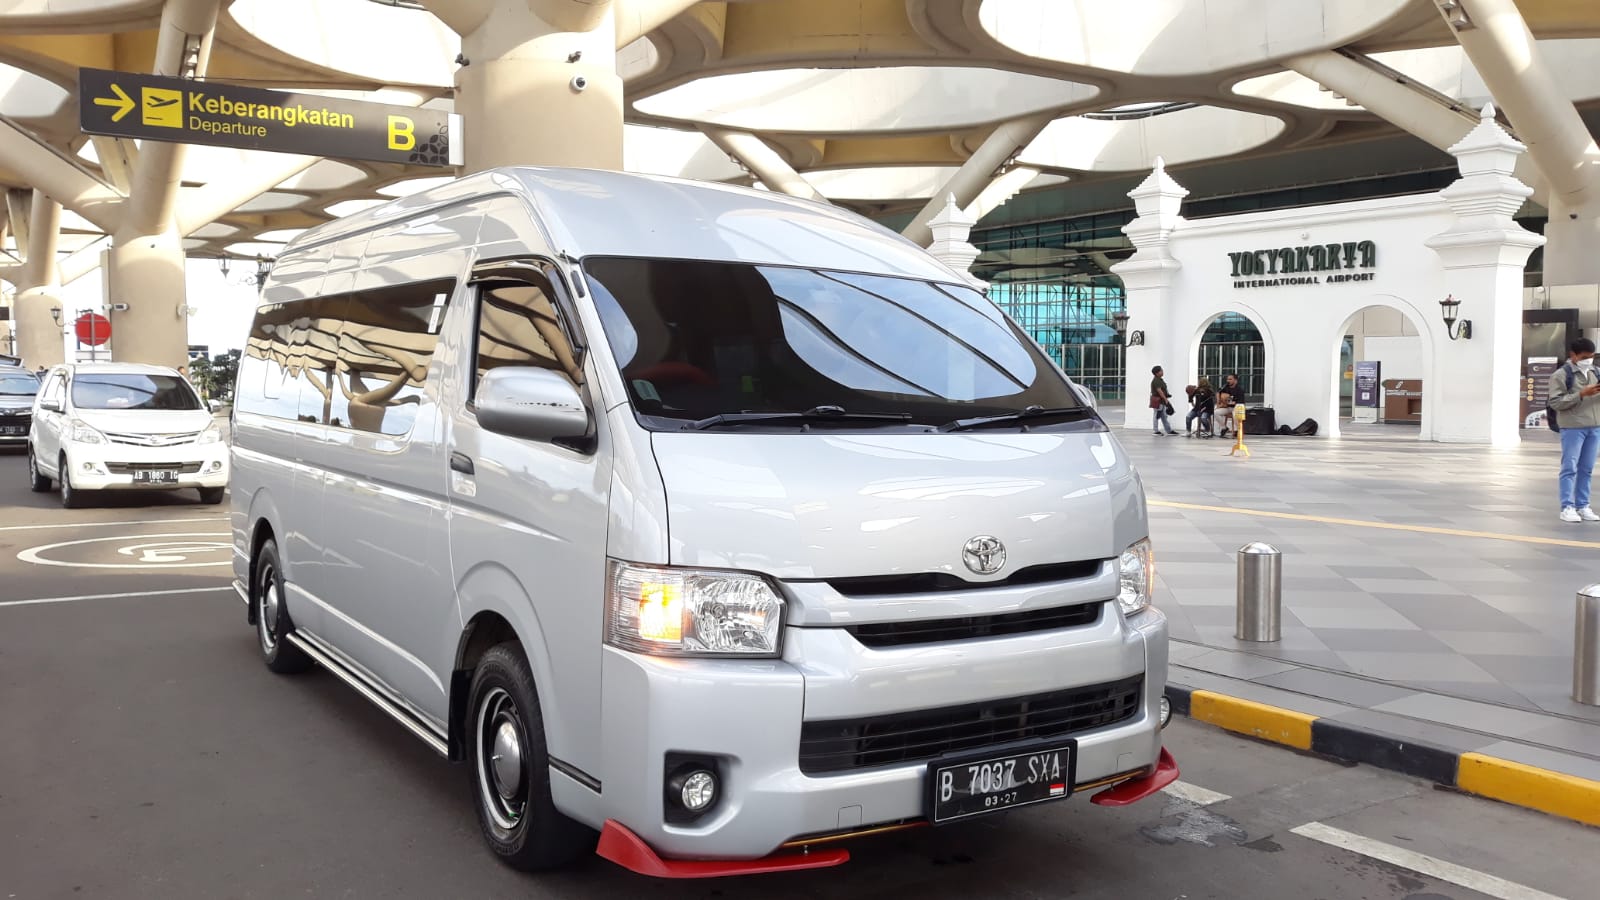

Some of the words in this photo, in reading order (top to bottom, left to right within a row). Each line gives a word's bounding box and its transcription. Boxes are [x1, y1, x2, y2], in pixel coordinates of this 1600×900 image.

[188, 92, 354, 128] Keberangkatan
[189, 117, 267, 137] Departure
[387, 115, 416, 151] B
[1228, 240, 1376, 277] YOGYAKARTA
[1234, 277, 1320, 288] INTERNATIONAL
[1326, 273, 1375, 284] AIRPORT
[941, 771, 953, 802] B
[968, 760, 1017, 796] 7037
[1027, 752, 1061, 784] SXA
